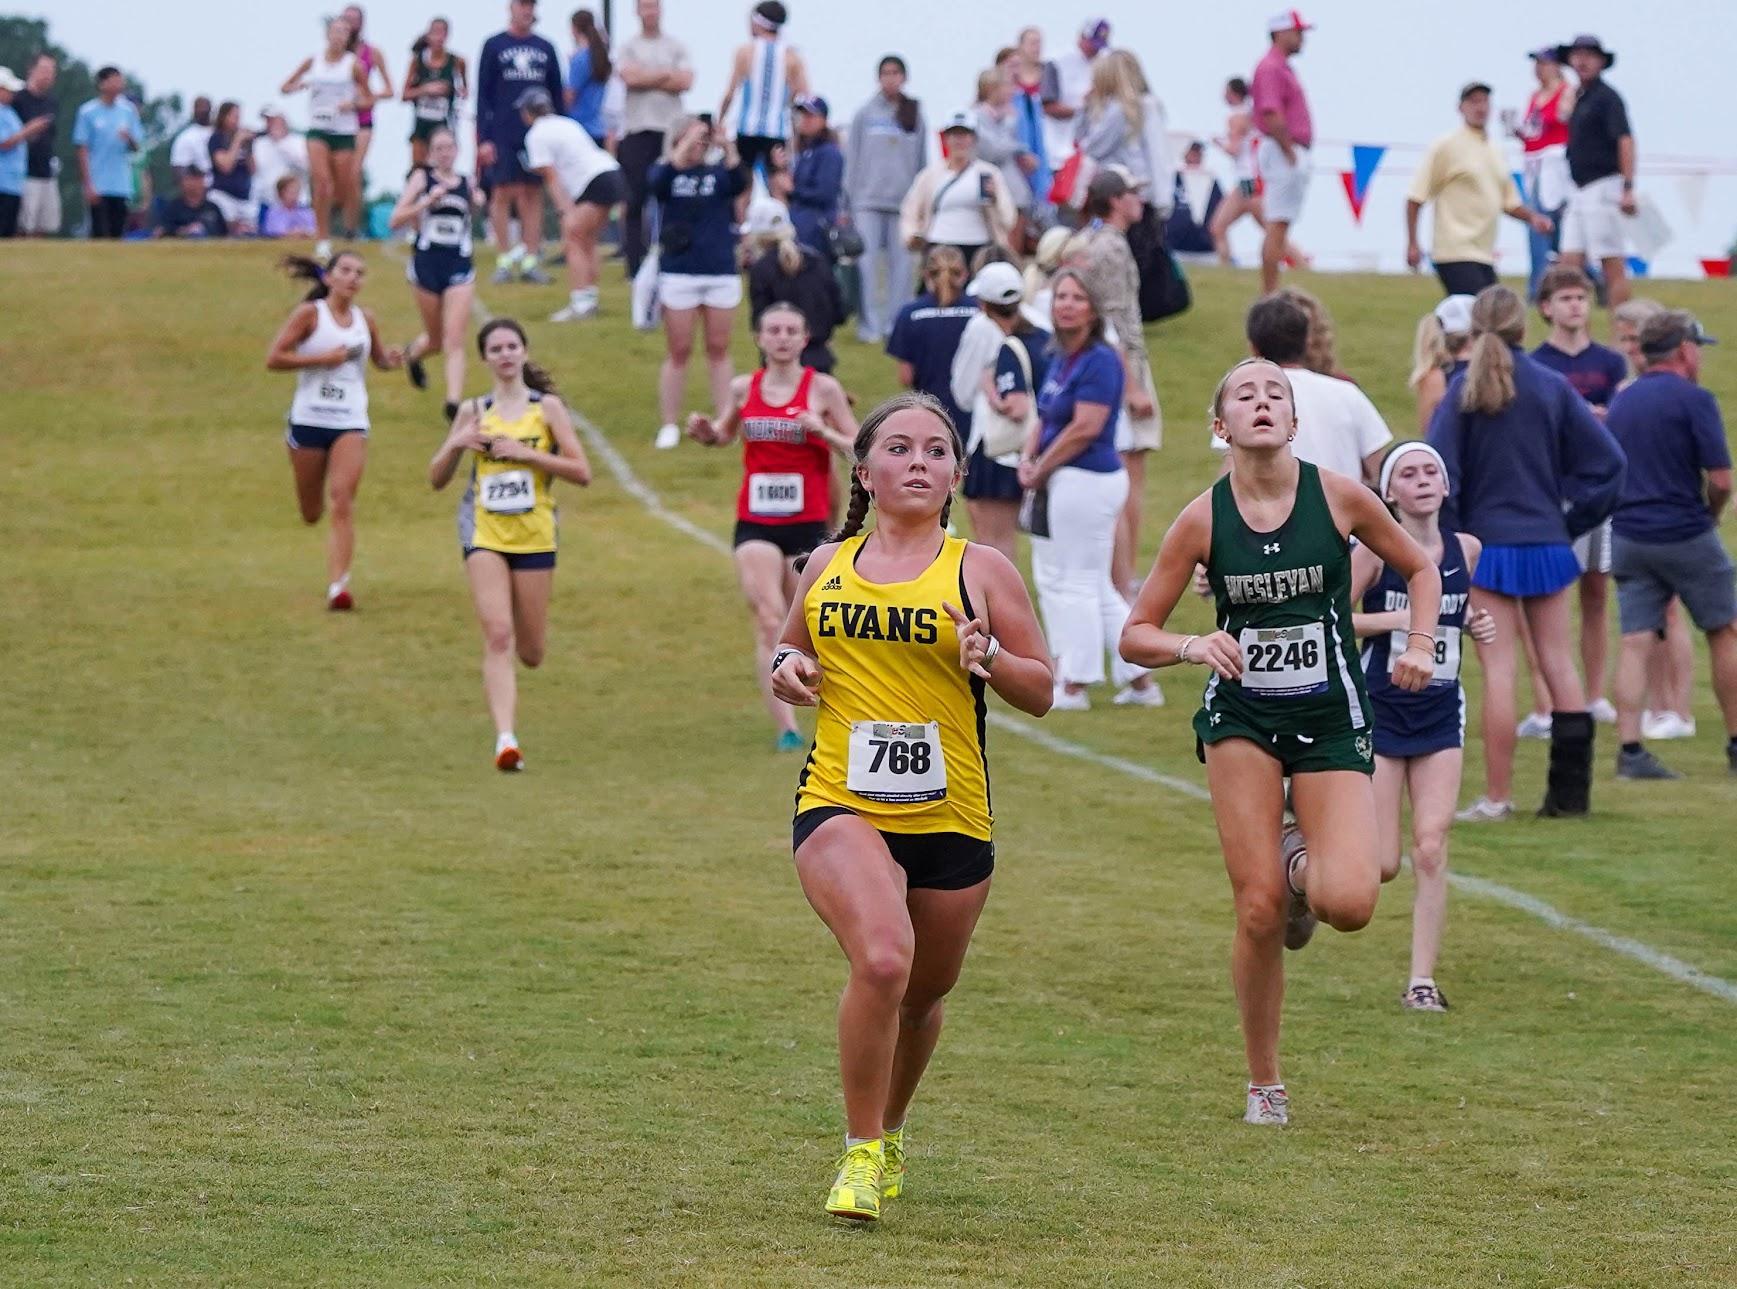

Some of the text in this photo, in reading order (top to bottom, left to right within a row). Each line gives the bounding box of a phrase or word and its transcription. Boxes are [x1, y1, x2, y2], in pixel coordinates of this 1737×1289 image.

[1224, 564, 1324, 605] WESLEYAN
[819, 602, 938, 645] EVANS
[1247, 639, 1319, 672] 2246
[868, 740, 931, 775] 768
